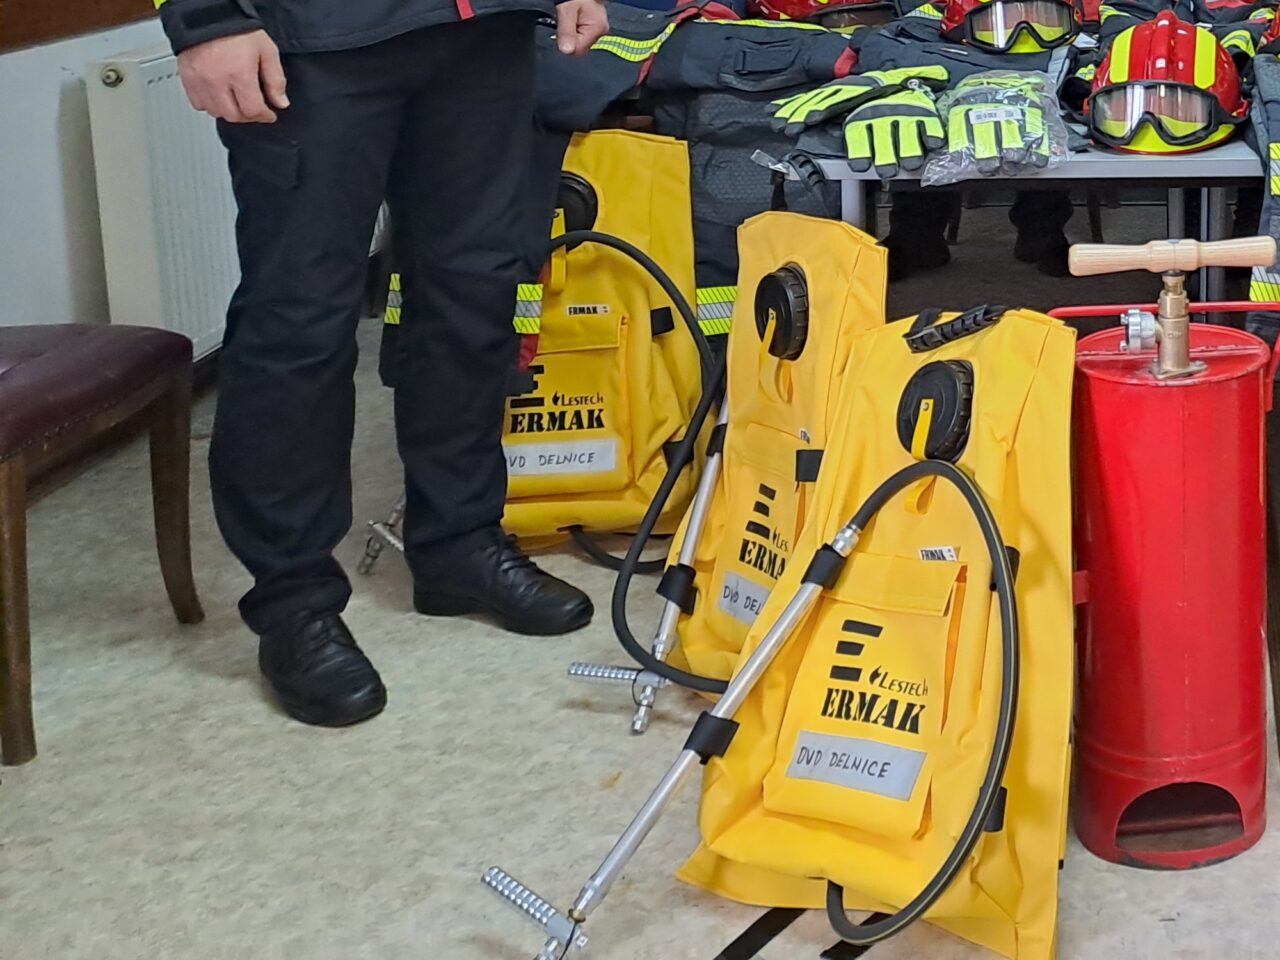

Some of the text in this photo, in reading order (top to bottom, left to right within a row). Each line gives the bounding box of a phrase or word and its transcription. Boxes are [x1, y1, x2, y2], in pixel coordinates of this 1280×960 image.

[509, 409, 606, 434] ERMAK
[508, 451, 596, 468] VD DELNICE
[738, 538, 787, 581] ERMA
[743, 596, 763, 617] DEL
[820, 687, 927, 735] ERMAK
[796, 746, 892, 779] DVD DELNICE
